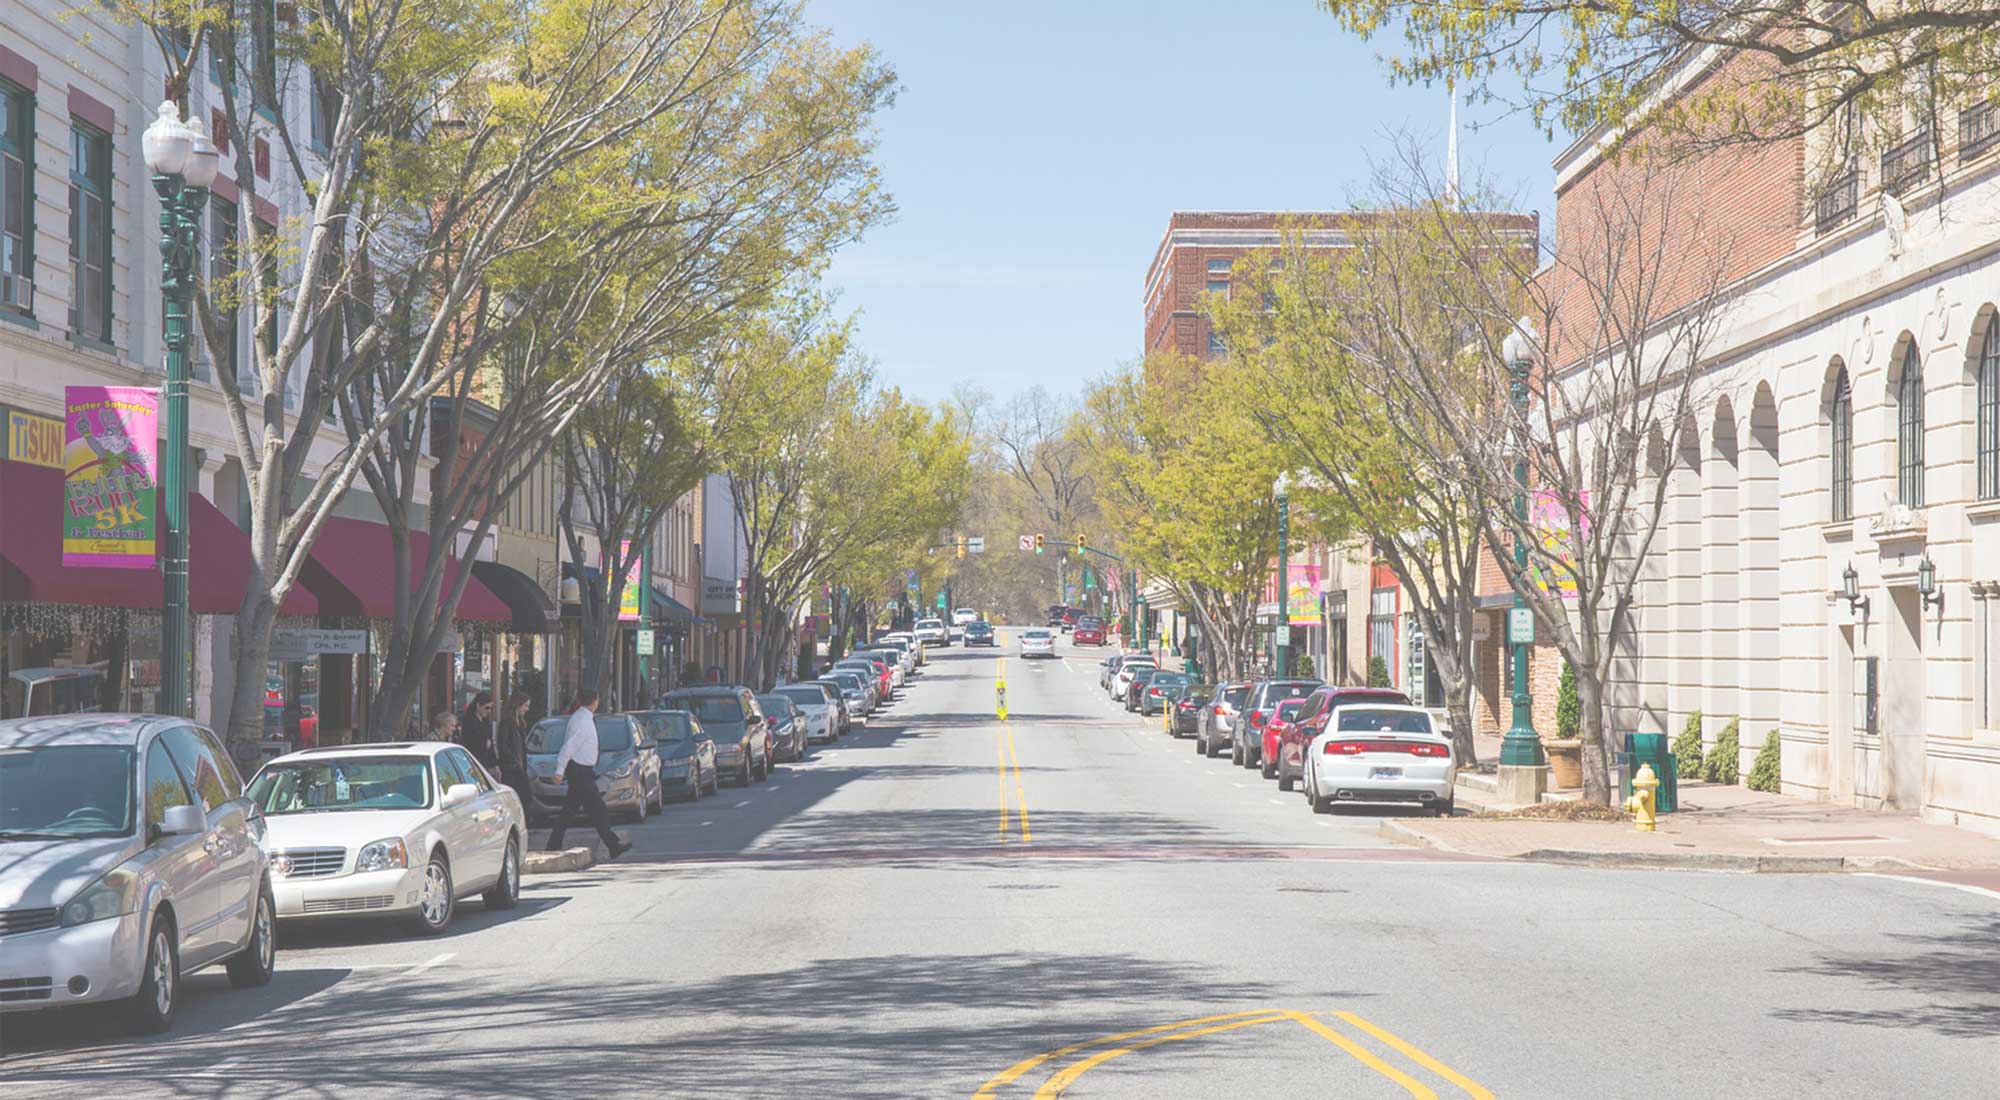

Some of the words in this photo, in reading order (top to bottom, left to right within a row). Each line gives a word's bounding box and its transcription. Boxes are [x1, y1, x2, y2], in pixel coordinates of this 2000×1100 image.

[68, 402, 101, 413] Easter
[104, 400, 152, 416] Saturday
[95, 498, 147, 530] 5K
